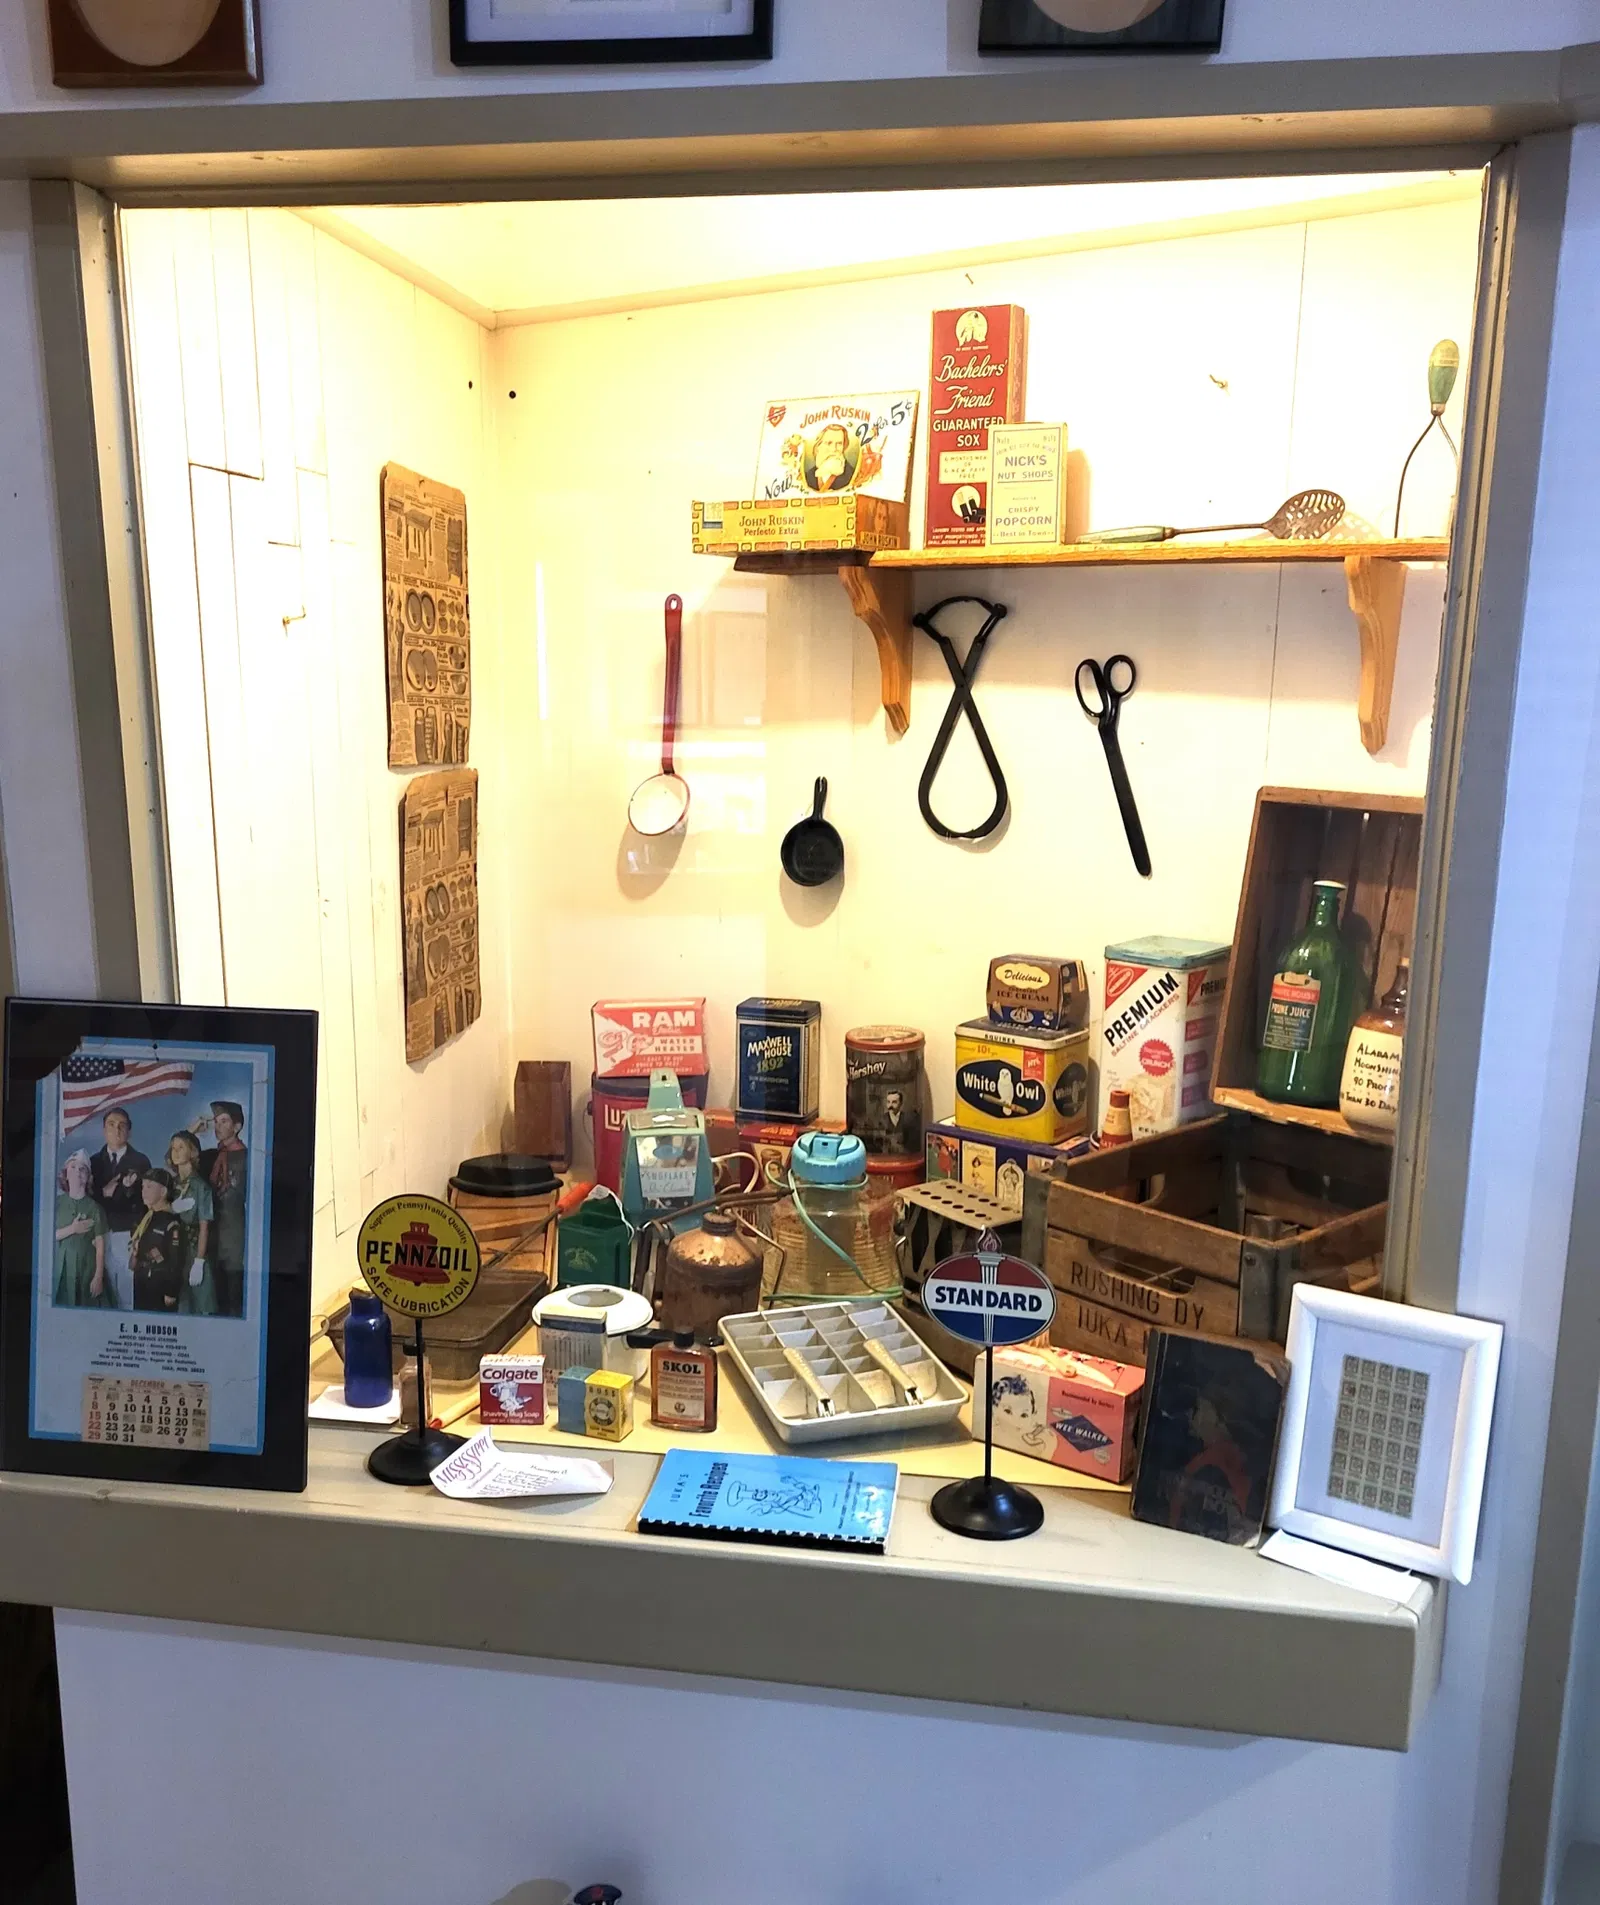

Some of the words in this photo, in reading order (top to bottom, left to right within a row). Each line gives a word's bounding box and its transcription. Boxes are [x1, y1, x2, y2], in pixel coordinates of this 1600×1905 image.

[935, 354, 1008, 382] Bachelors'
[933, 385, 996, 415] Friend
[800, 410, 829, 428] JOHN
[831, 405, 871, 423] RUSKIN
[856, 423, 873, 446] 2
[957, 434, 980, 447] SOX
[1005, 454, 1047, 467] NICK'S
[997, 471, 1016, 480] NUT
[1022, 470, 1054, 479] SHOPS
[1008, 506, 1040, 514] CRISPY
[739, 515, 766, 527] JOHN
[769, 514, 805, 526] RUSKIN
[995, 515, 1052, 527] POPCORN
[744, 528, 776, 536] Perfecto
[778, 527, 799, 535] Extra
[862, 532, 877, 545] JOHN
[1004, 969, 1043, 983] Delicious
[996, 990, 1013, 998] ICE
[1015, 991, 1050, 1002] CREAM
[1104, 972, 1180, 1047] PREMIUM
[1289, 1006, 1311, 1018] JUICE
[632, 1010, 696, 1029] RAM
[747, 1036, 792, 1057] MAXWELL
[1111, 1030, 1139, 1057] SALTINE
[764, 1045, 792, 1059] HOUSE
[1357, 1043, 1400, 1062] ALABAM
[756, 1057, 784, 1074] 1892
[849, 1062, 886, 1080] Hershey
[1354, 1057, 1399, 1075] MOONSHIN
[963, 1072, 996, 1093] White
[1016, 1082, 1040, 1101] Owl
[1353, 1076, 1364, 1087] 90
[369, 1206, 397, 1232] Supreme
[397, 1201, 448, 1219] Pennsylvania
[447, 1216, 468, 1245] Quality
[365, 1240, 472, 1273] PENNZOIL
[366, 1266, 393, 1298] SAFE
[392, 1277, 471, 1313] LUBRICATION
[1071, 1261, 1160, 1315] RUSHING
[1174, 1297, 1204, 1330] DY
[935, 1286, 1043, 1313] STANDARD
[120, 1323, 128, 1333] E.
[146, 1325, 178, 1336] HUDSON
[1078, 1305, 1128, 1348] IUKA
[482, 1368, 539, 1382] Colgate
[663, 1360, 701, 1374] SKOL
[131, 1379, 165, 1389] DECEMBER
[127, 1394, 134, 1402] 3
[144, 1395, 150, 1404] 4
[162, 1396, 168, 1405] 5
[179, 1397, 186, 1407] 6
[196, 1398, 203, 1408] 7
[109, 1402, 116, 1411] 9
[124, 1403, 137, 1413] 10
[141, 1405, 153, 1414] 11
[159, 1406, 171, 1416] 12
[176, 1408, 189, 1417] 13
[483, 1410, 508, 1418] Shaving
[89, 1411, 101, 1420] 15
[106, 1412, 119, 1421] 16
[141, 1415, 153, 1424] 18
[158, 1416, 171, 1426] 19
[175, 1417, 189, 1427] 20
[88, 1421, 101, 1430] 22
[105, 1422, 118, 1431] 23
[122, 1423, 135, 1433] 24
[157, 1426, 170, 1436] 26
[174, 1427, 188, 1437] 27
[1055, 1422, 1072, 1433] WEE
[1075, 1427, 1108, 1443] WALKER
[105, 1432, 119, 1442] 30
[122, 1434, 134, 1443] 31
[700, 1463, 729, 1490] Recipes
[689, 1490, 718, 1518] Favorite
